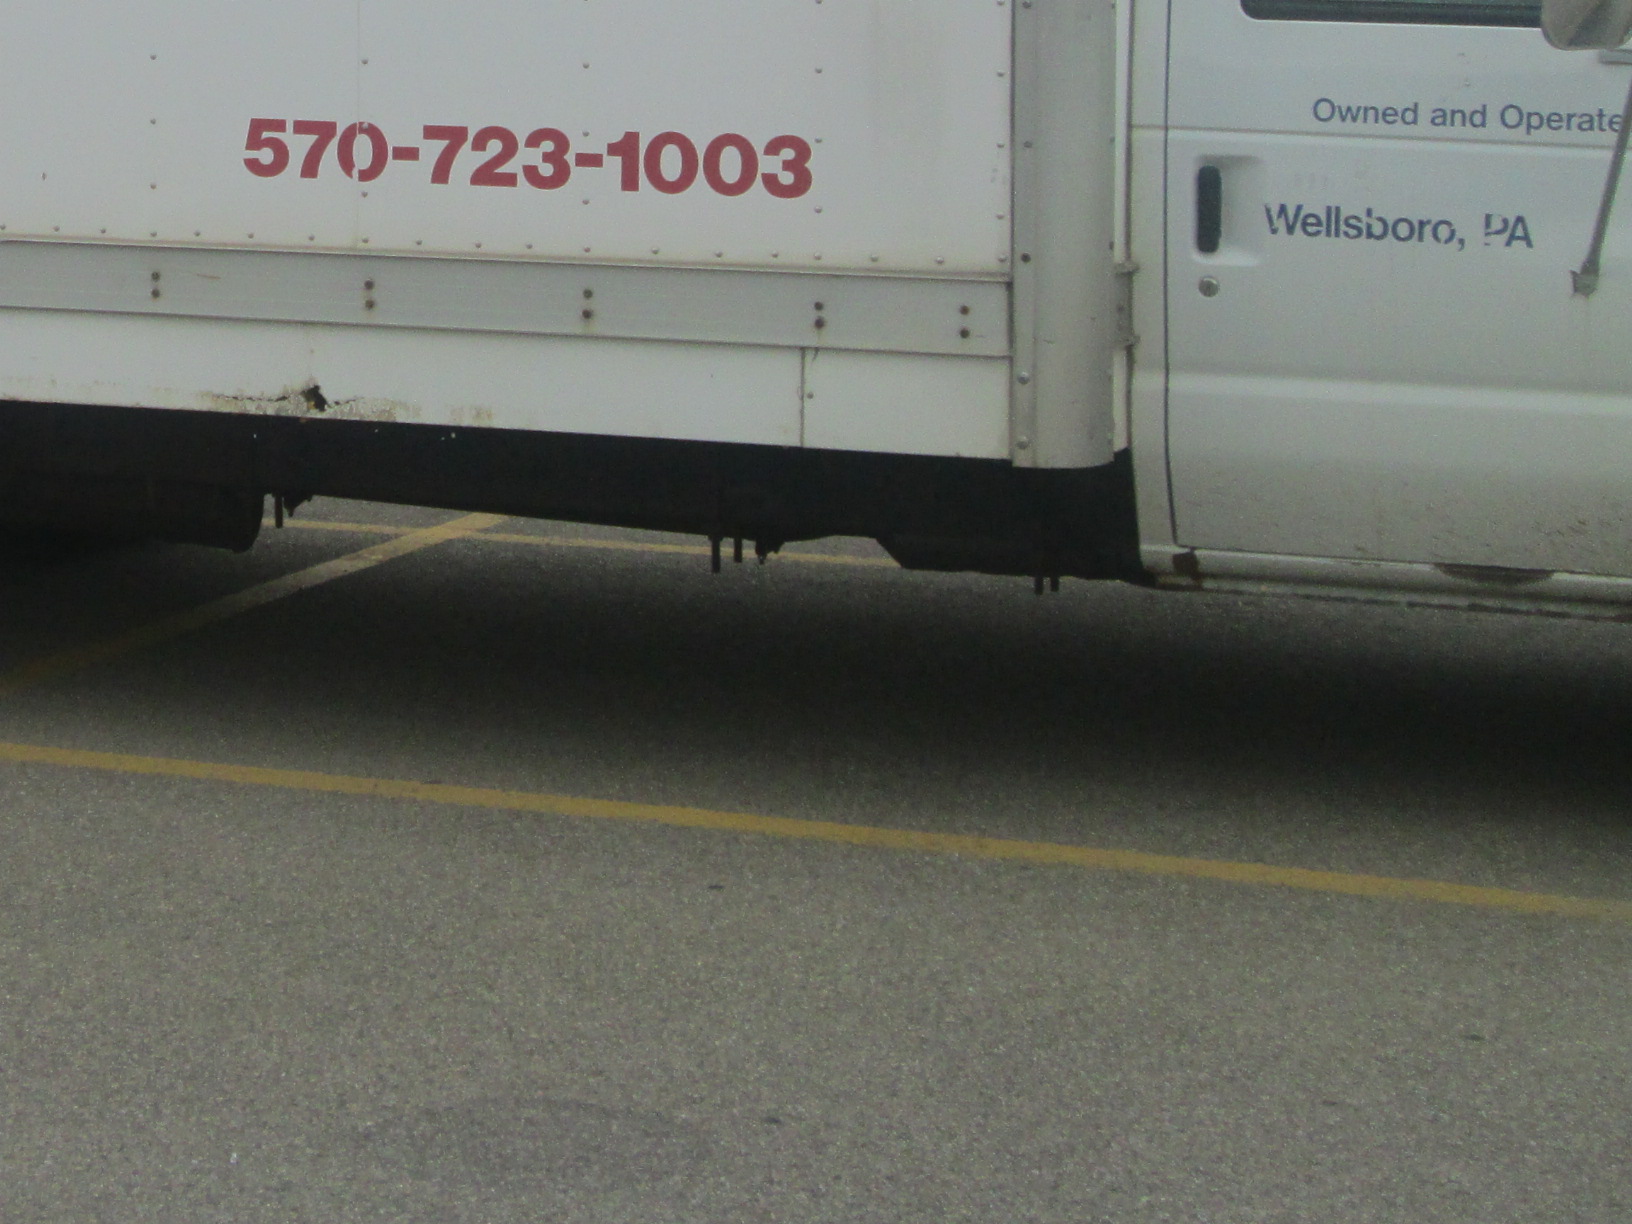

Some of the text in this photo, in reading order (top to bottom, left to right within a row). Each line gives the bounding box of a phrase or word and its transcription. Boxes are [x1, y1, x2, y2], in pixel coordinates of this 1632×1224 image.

[1312, 98, 1623, 135] Owned and Operate
[243, 118, 813, 199] 570-723-1003
[1264, 203, 1533, 251] Wellsboro, PA
